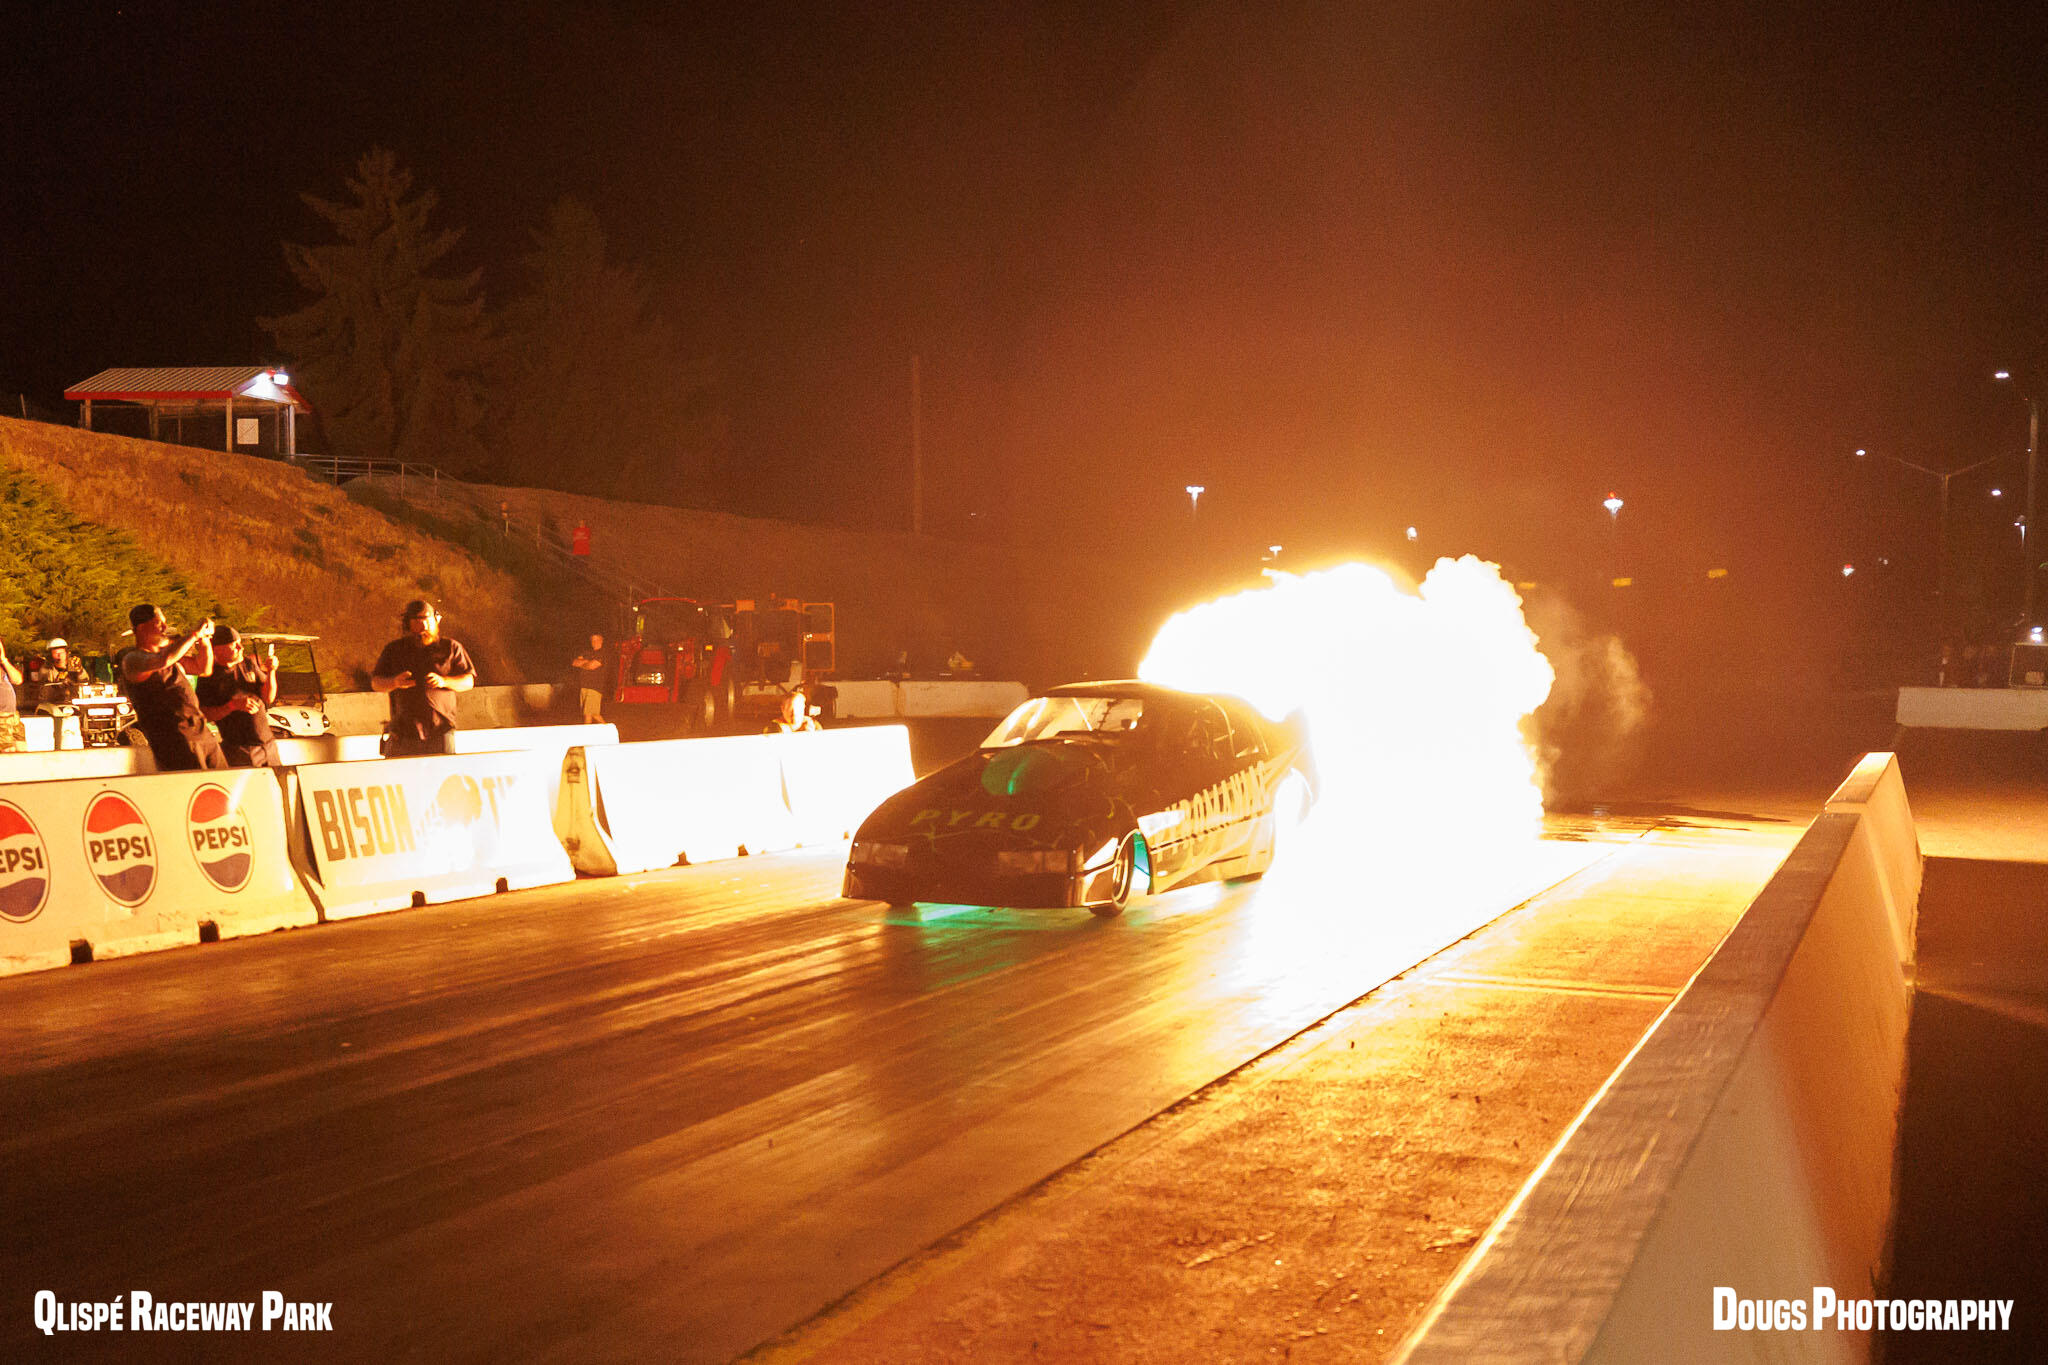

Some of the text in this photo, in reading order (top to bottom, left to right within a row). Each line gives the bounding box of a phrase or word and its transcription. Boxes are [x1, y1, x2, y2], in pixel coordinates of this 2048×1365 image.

[313, 783, 416, 862] BISON
[909, 809, 1041, 831] PYRO
[89, 836, 152, 863] PEPSI
[192, 826, 249, 852] PEPSI
